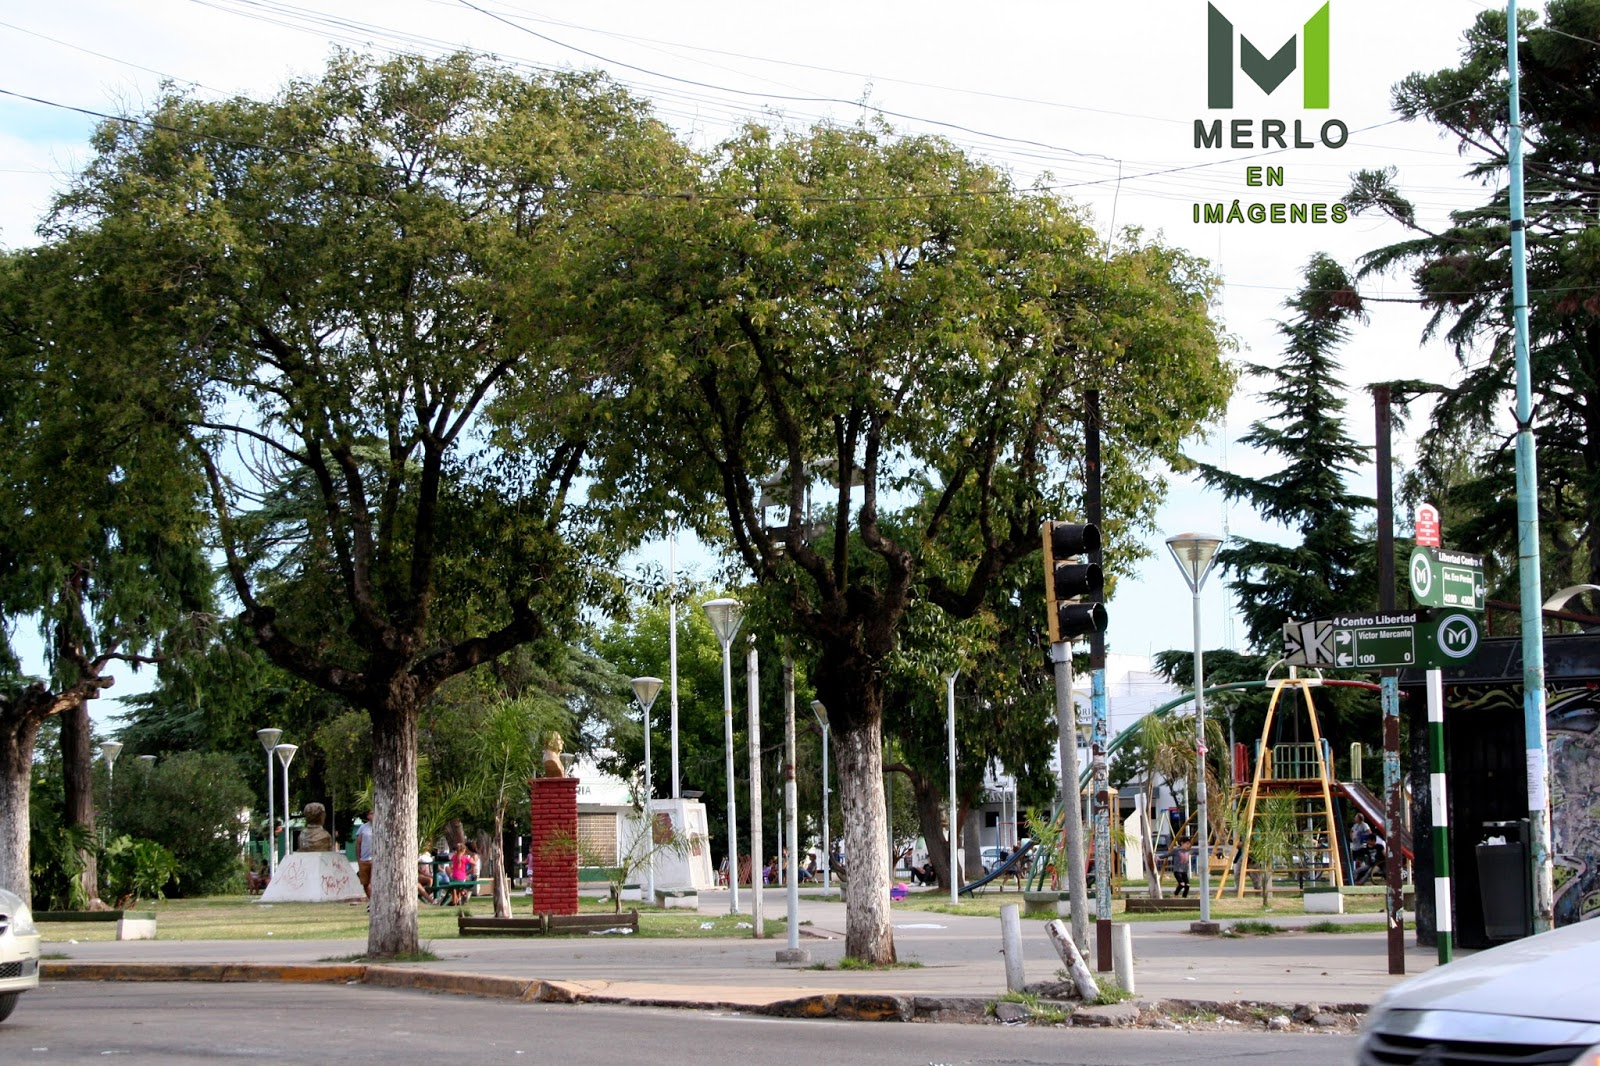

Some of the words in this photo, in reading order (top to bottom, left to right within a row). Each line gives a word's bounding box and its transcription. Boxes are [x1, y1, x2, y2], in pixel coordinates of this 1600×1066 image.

[1438, 551, 1460, 565] Libertad
[1460, 555, 1478, 567] Centro
[1333, 617, 1340, 626] 4
[1341, 617, 1374, 627] Centro
[1375, 613, 1417, 625] Libertad
[1379, 629, 1412, 639] Mercante
[1358, 654, 1376, 664] 100
[1403, 652, 1411, 661] 0
